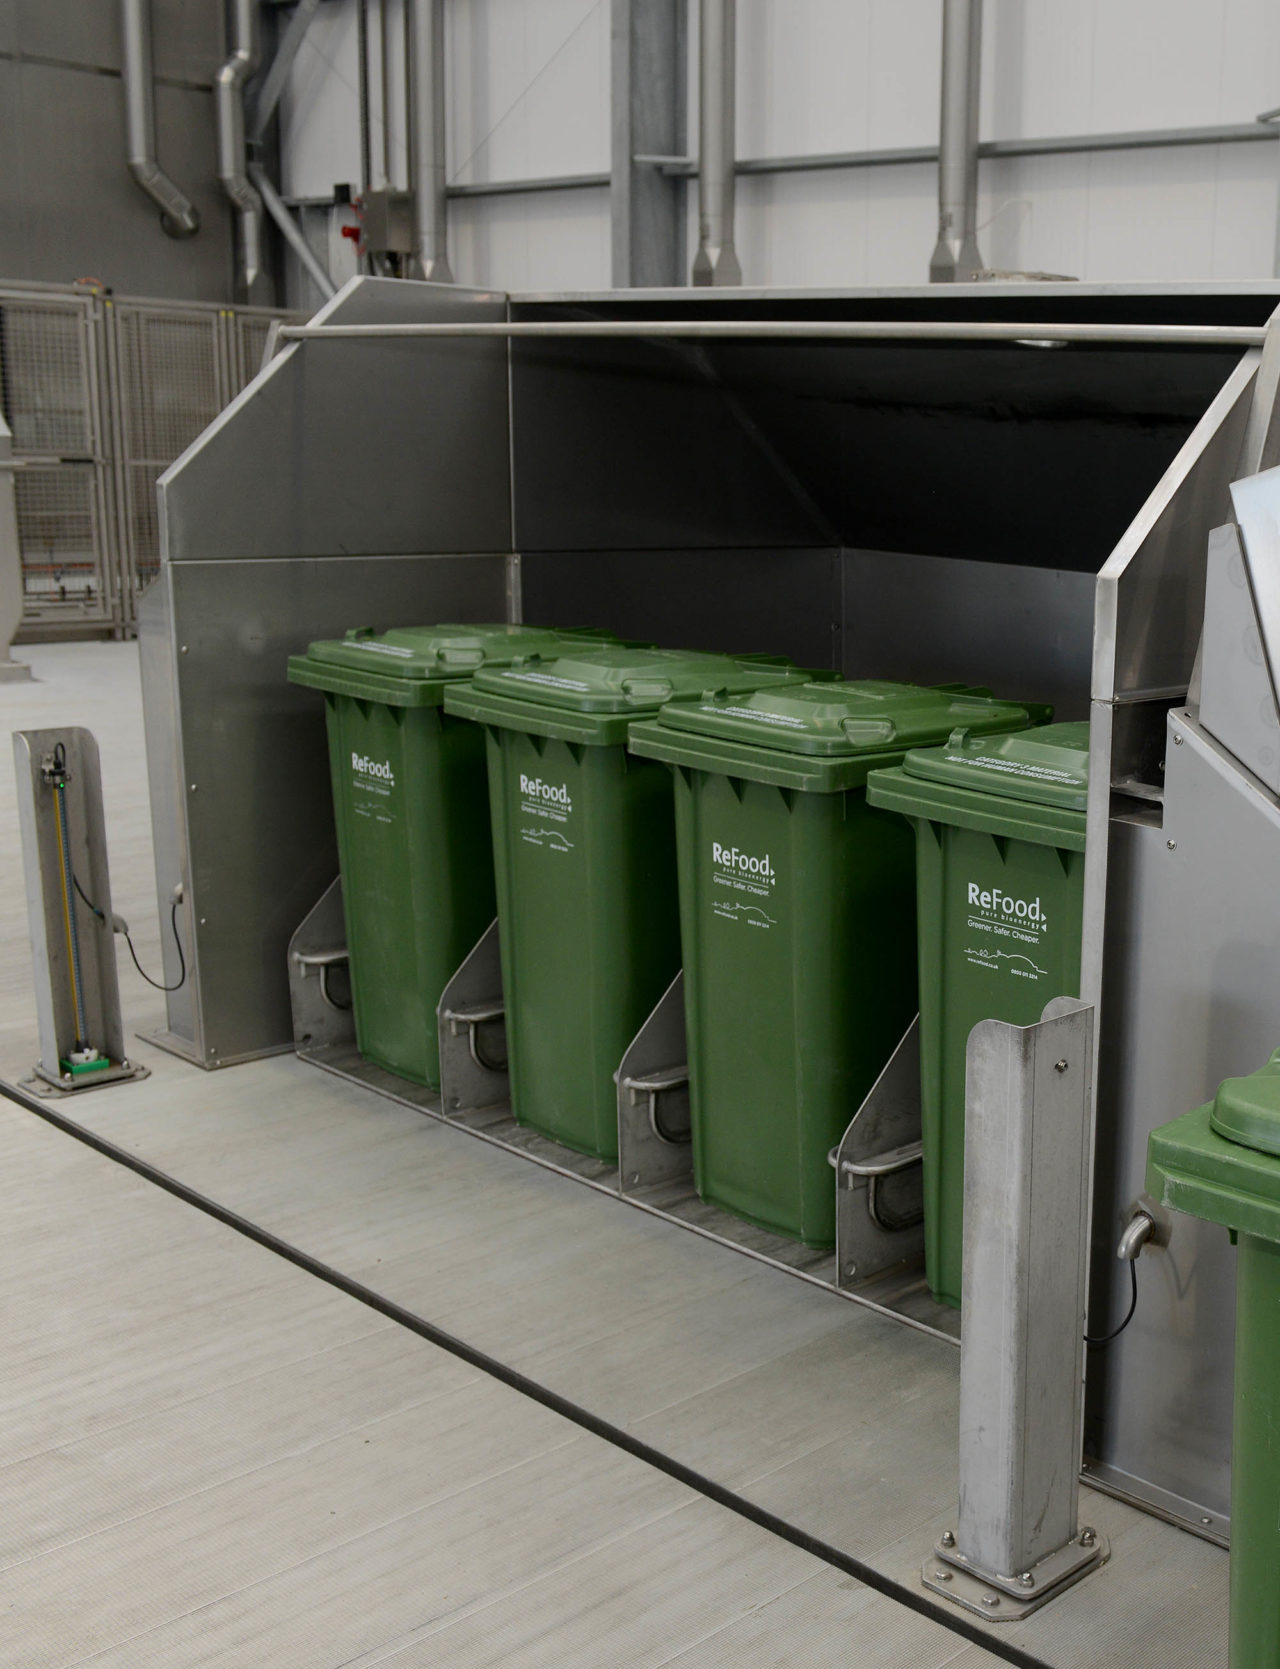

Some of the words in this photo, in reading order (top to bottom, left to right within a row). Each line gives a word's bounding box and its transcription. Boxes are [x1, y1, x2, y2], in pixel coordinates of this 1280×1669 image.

[351, 752, 390, 779] ReFood
[520, 774, 567, 803] ReFood
[713, 842, 769, 875] ReFood
[968, 882, 1040, 921] ReFood
[967, 919, 993, 933] Greener.
[993, 926, 1011, 937] Safer.
[1012, 930, 1040, 944] Cheaper.
